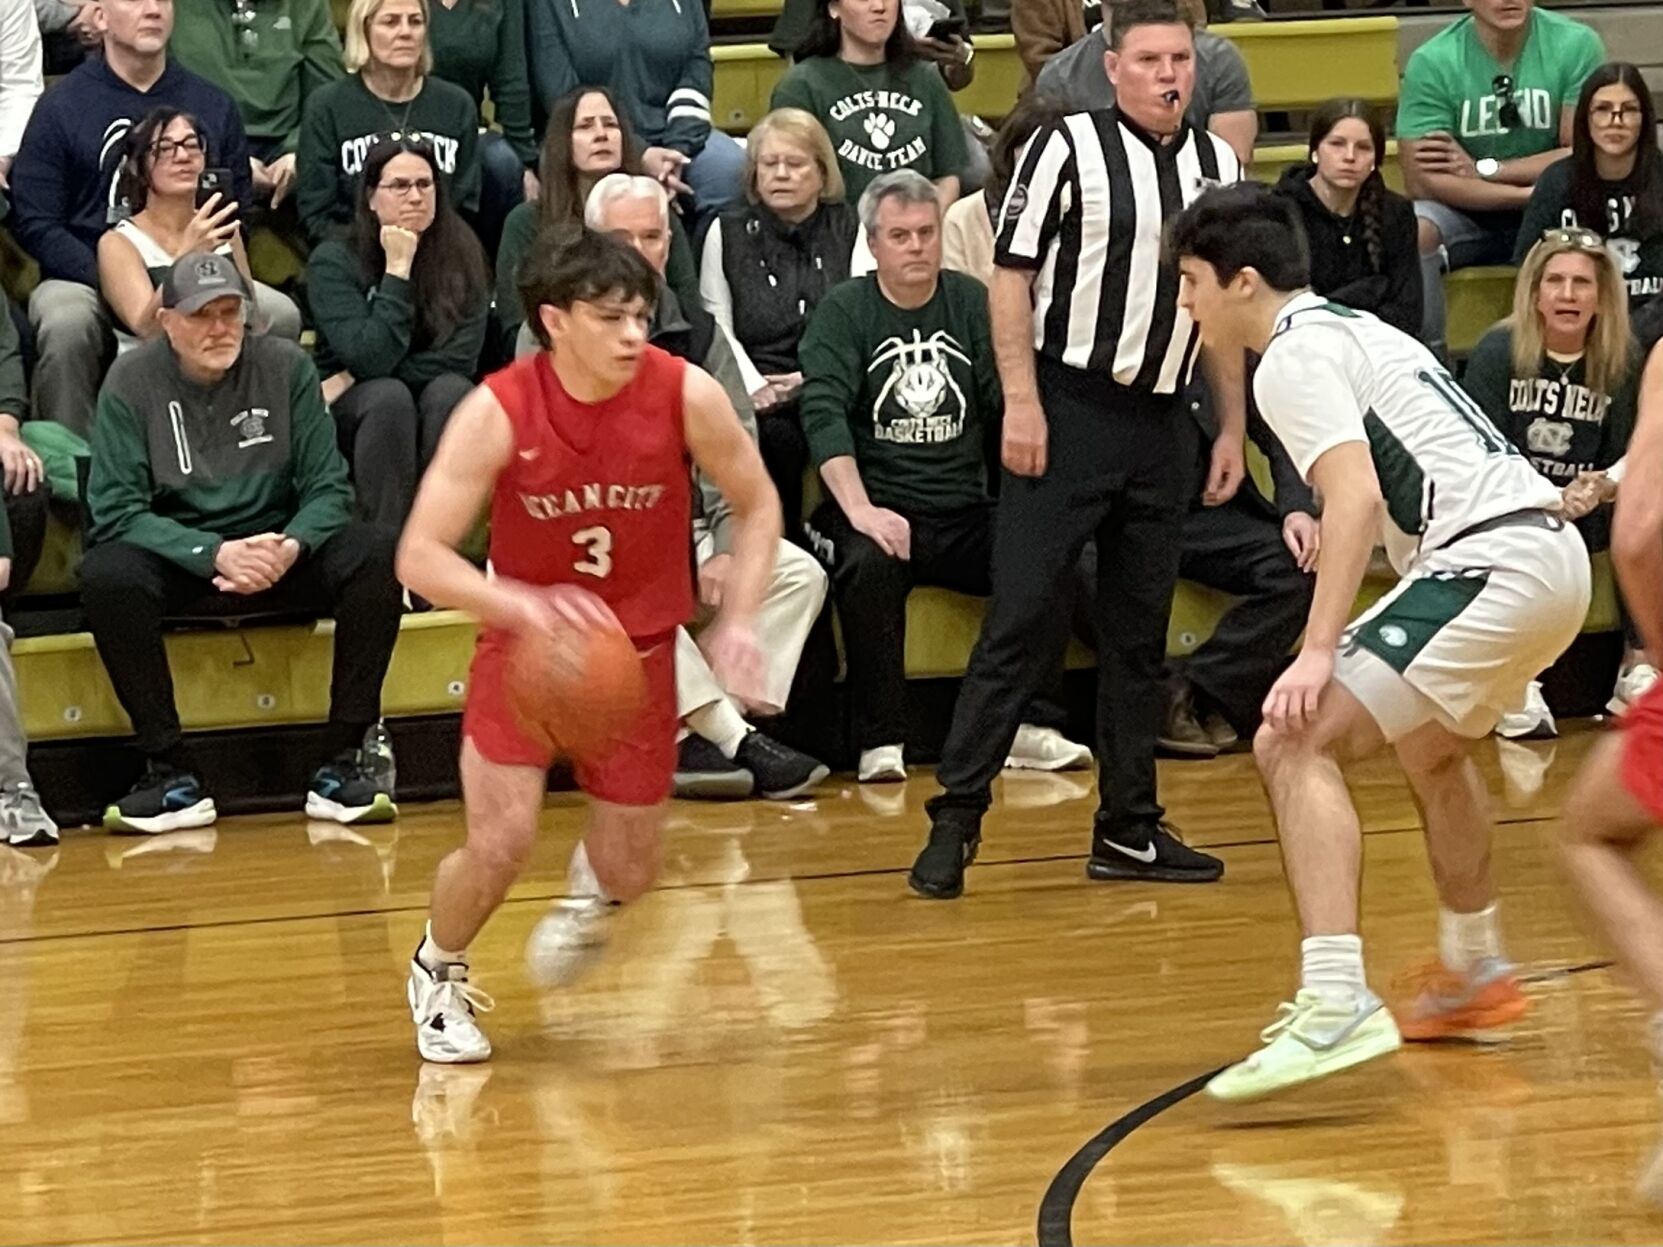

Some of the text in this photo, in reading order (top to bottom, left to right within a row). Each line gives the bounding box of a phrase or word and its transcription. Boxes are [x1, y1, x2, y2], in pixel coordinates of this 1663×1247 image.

[877, 90, 923, 117] NECK
[837, 136, 927, 171] DANCE TEAM
[1509, 378, 1561, 415] COLTS
[607, 484, 666, 511] CITY
[570, 525, 612, 579] 3
